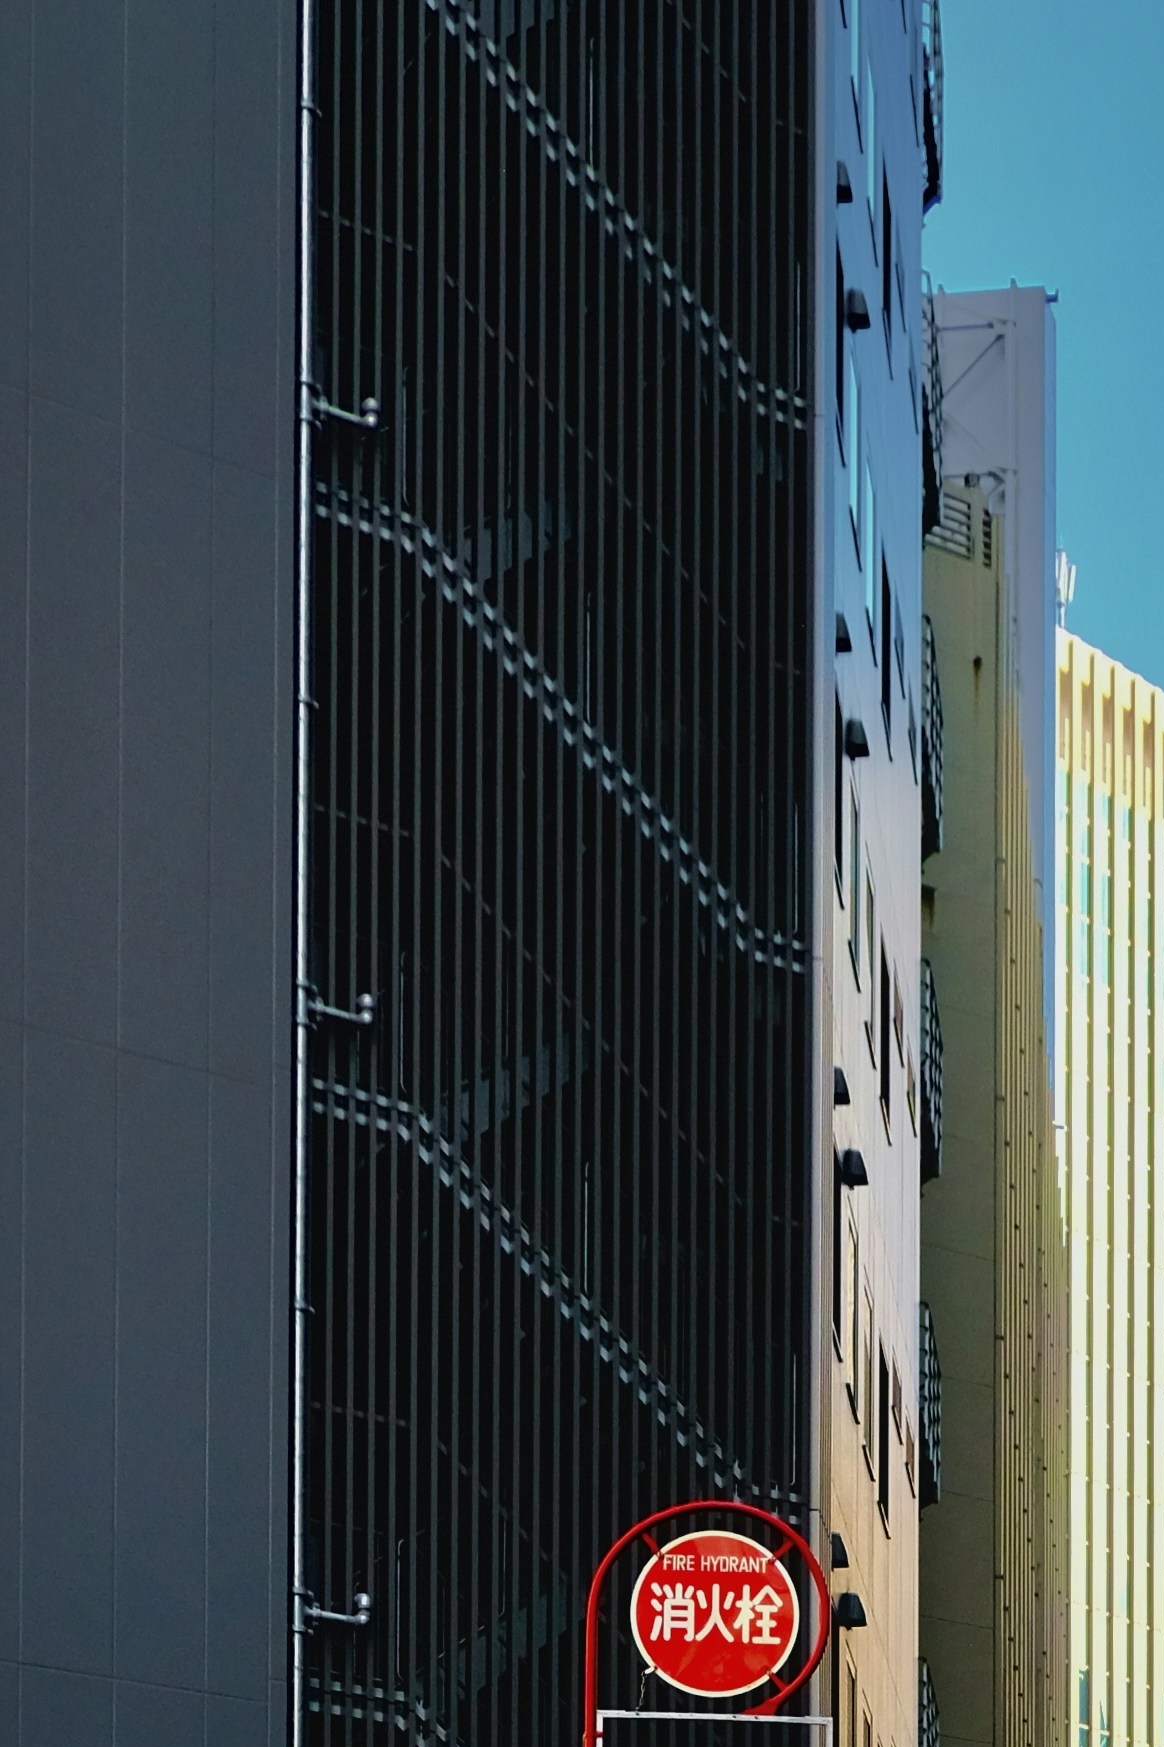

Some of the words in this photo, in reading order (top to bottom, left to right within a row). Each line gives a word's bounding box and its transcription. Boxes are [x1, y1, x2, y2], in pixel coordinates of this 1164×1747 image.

[663, 1555, 695, 1571] FIRE
[701, 1555, 768, 1574] HYDRANT
[650, 1583, 784, 1645] 消火栓
